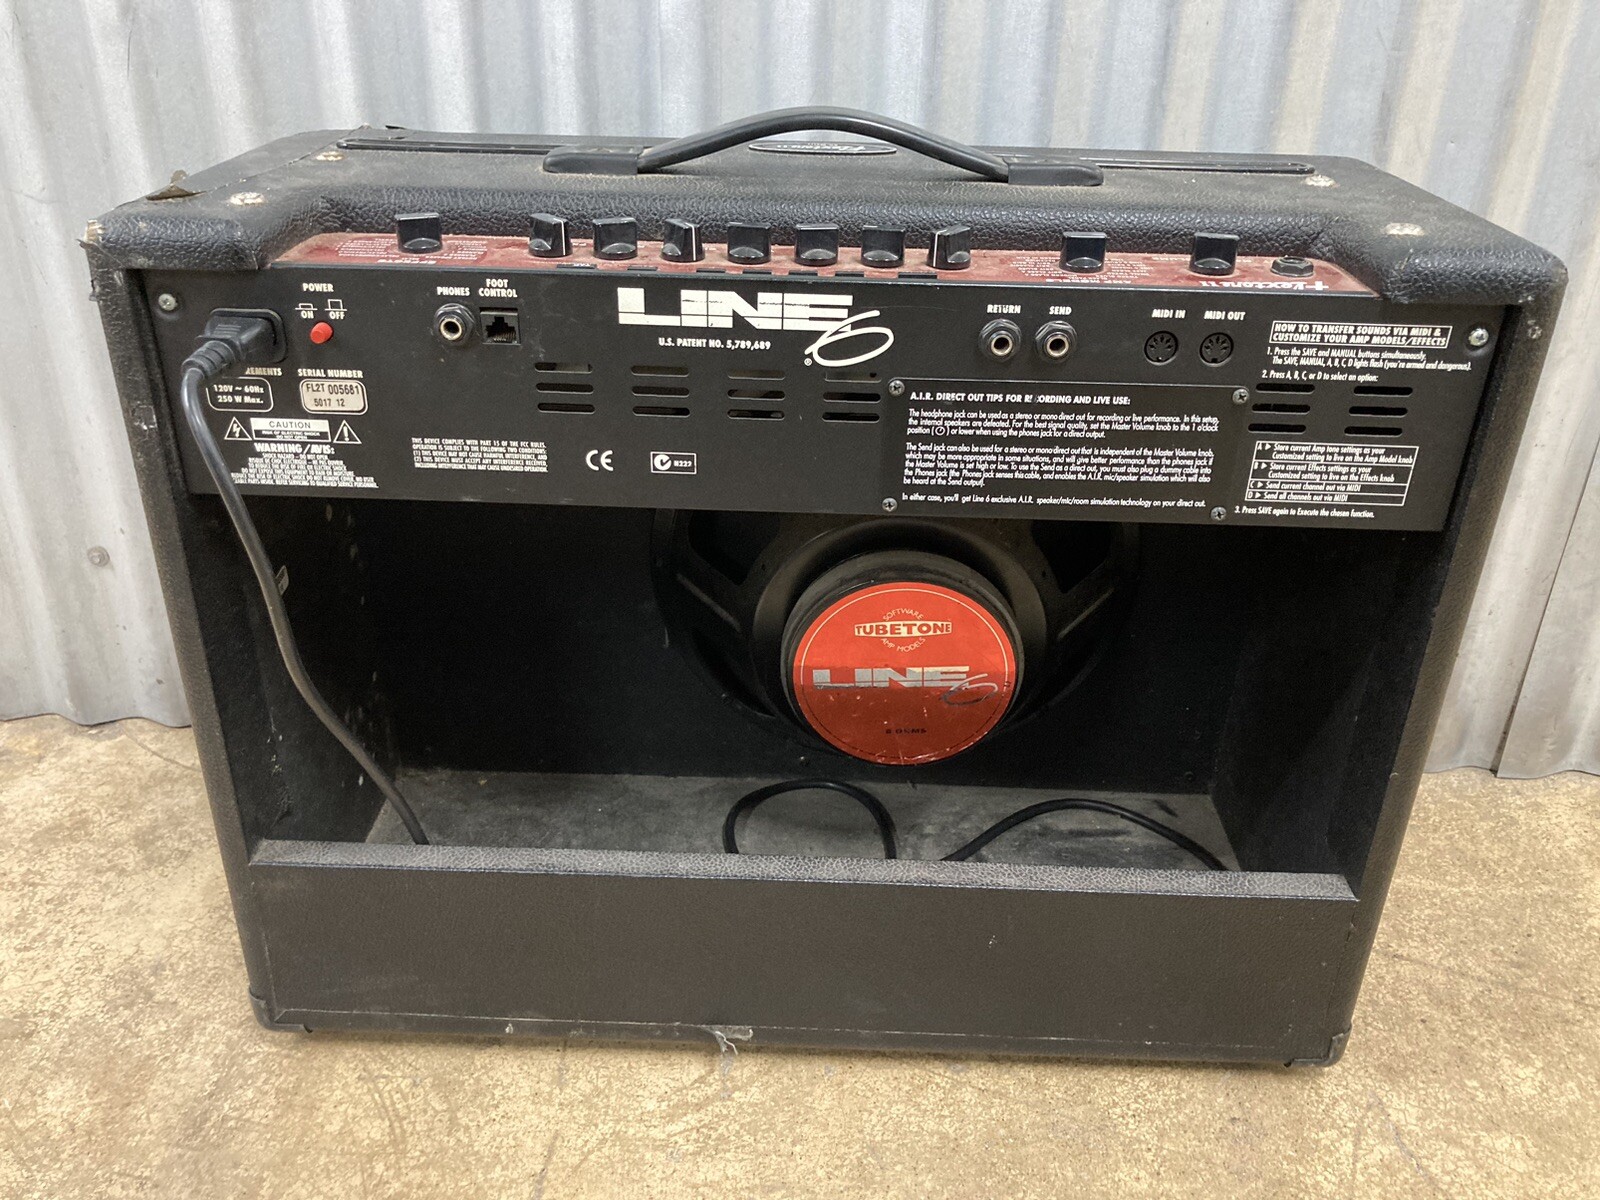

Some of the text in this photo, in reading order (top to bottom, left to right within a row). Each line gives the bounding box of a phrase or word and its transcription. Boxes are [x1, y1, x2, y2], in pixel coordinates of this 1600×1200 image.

[302, 283, 334, 293] POWER
[486, 278, 508, 288] FOOT
[437, 286, 470, 297] PHONES
[479, 287, 517, 298] CONTROL
[301, 311, 314, 319] ON
[617, 287, 853, 332] LINE
[987, 304, 1021, 314] RETURN
[1049, 306, 1072, 316] SEND
[1151, 308, 1186, 319] MIDI IN
[329, 311, 345, 320] OFF
[1203, 310, 1246, 321] MIDI OUT
[1275, 323, 1296, 332] HOW
[1298, 324, 1310, 332] TO
[1312, 324, 1354, 334] TRANSFER
[1356, 326, 1391, 335] SOUNDS
[1393, 327, 1408, 336] VIA
[1409, 327, 1432, 336] MIDI
[658, 337, 771, 350] U.S. PATENT NO. 5,789,689
[1272, 333, 1446, 346] CUSTOMIZE YOUR AMP MODELS/EFFECTS
[1267, 346, 1272, 355] 1.
[1274, 347, 1290, 356] Press
[1291, 347, 1301, 356] the
[1302, 348, 1317, 356] SAVE
[1318, 348, 1330, 356] and
[1330, 348, 1356, 357] MANUAL
[1358, 349, 1380, 358] buttons
[297, 368, 363, 378] SERIAL NUMBER
[1262, 370, 1268, 378] 2.
[1269, 370, 1285, 378] Press
[1317, 372, 1322, 380] D
[1330, 372, 1347, 380] select
[1357, 374, 1378, 383] option:
[306, 383, 360, 395] FL2T 005681
[314, 398, 345, 407] 5017 12
[910, 391, 1130, 405] A.I.R. DIRECT OUT TIPS FOR RORDING AND LIVE USE:
[909, 408, 920, 417] The
[920, 409, 953, 419] headphone
[953, 410, 965, 419] jack
[979, 410, 986, 419] be
[988, 410, 1002, 419] used
[1015, 412, 1032, 420] stereo
[1058, 411, 1075, 420] direct
[1076, 413, 1086, 421] out
[1087, 412, 1095, 421] for
[1096, 413, 1123, 423] recording
[1132, 413, 1142, 422] live
[1143, 413, 1181, 423] performance.
[1184, 414, 1190, 422] In
[1191, 414, 1201, 423] this
[1202, 416, 1220, 424] setup,
[269, 421, 311, 429] CAUTION
[254, 442, 302, 453] WARNING
[586, 449, 614, 471] CE
[902, 492, 908, 500] In
[909, 493, 926, 501] either
[943, 493, 959, 503] you'll
[961, 495, 971, 504] get
[972, 494, 984, 502] Line
[985, 494, 989, 502] 6
[990, 495, 1016, 504] exclusive
[1036, 496, 1089, 505] speaker/mic/room
[1090, 496, 1120, 505] simulation
[1120, 498, 1152, 508] technology
[1162, 500, 1175, 508] your
[1176, 498, 1194, 507] direct
[1234, 505, 1240, 513] 3.
[1241, 505, 1257, 514] Press
[1272, 508, 1289, 517] again
[1297, 507, 1319, 516] Execute
[1320, 508, 1329, 516] the
[1330, 508, 1350, 517] chosen
[1350, 508, 1375, 518] function.
[882, 608, 924, 622] SOFTWARE
[856, 622, 951, 635] TUBETONE
[881, 637, 926, 653] AMP MODELS
[812, 665, 969, 689] LINE
